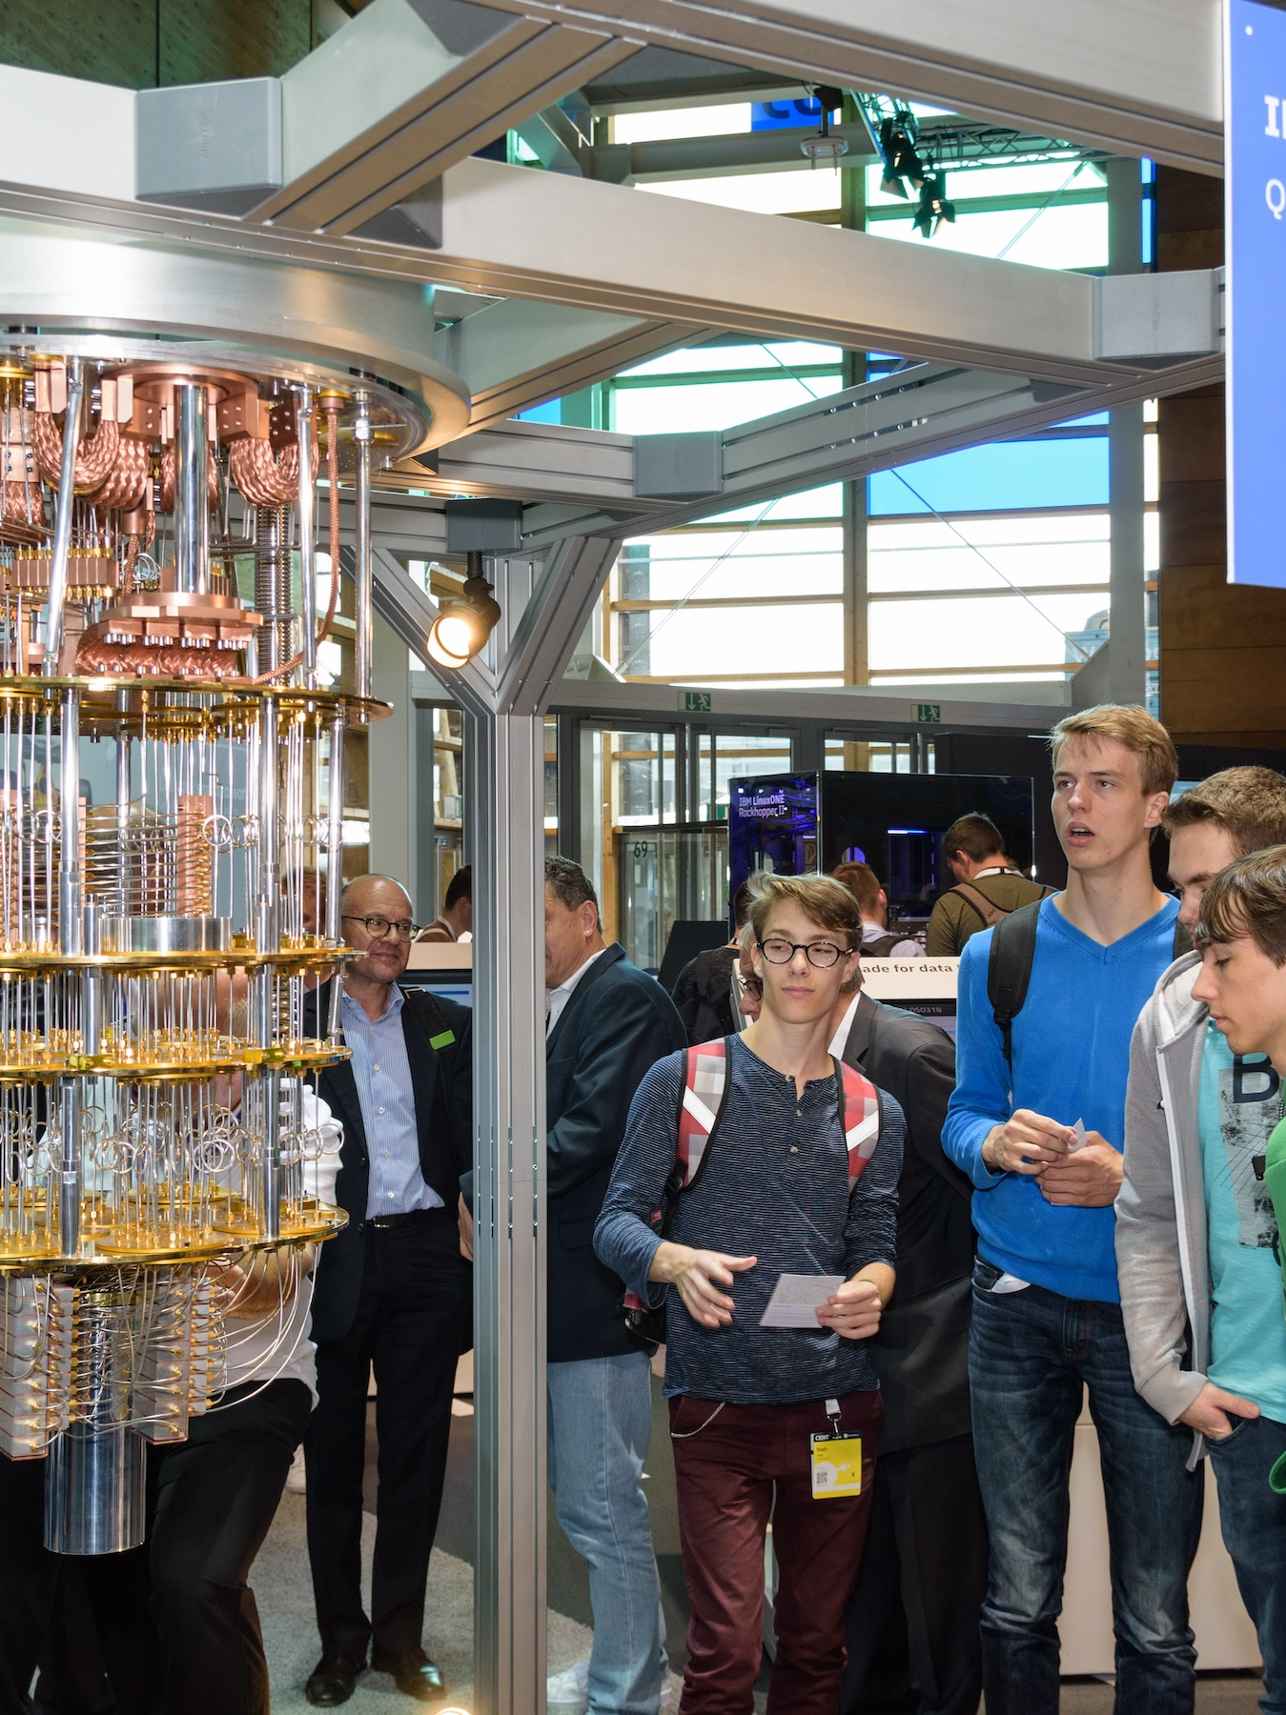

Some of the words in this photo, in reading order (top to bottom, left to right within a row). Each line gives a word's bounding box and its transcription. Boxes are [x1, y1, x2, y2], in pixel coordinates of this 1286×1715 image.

[739, 797, 752, 807] IBM
[753, 793, 785, 806] LinuxONE
[739, 807, 777, 819] Rockhopper
[634, 841, 648, 858] 69
[863, 964, 889, 973] ade
[894, 964, 915, 973] for
[920, 964, 953, 973] data
